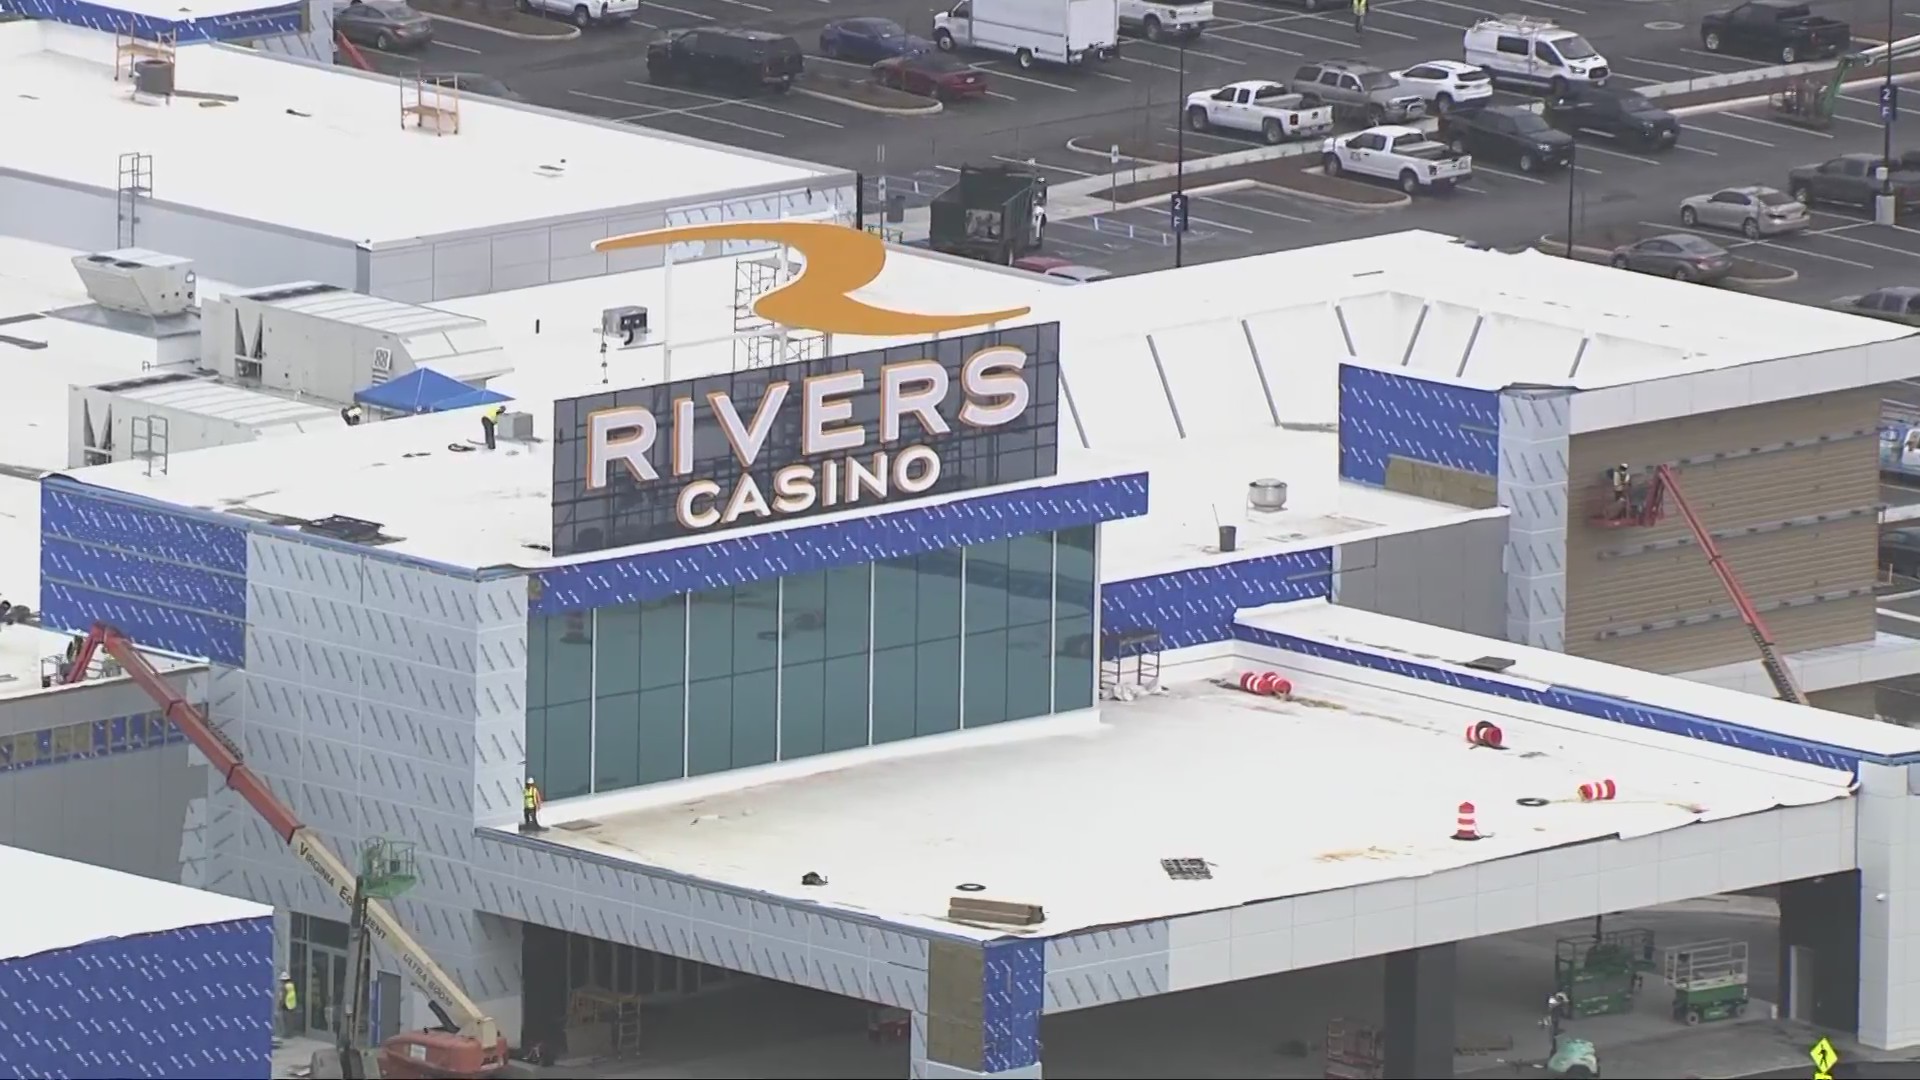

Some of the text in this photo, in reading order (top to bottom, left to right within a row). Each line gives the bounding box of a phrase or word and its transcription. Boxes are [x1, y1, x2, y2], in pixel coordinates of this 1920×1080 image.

[1882, 88, 1891, 100] 2
[1174, 197, 1182, 210] 2
[586, 345, 1030, 490] RIVERS
[676, 445, 941, 528] CASINO
[299, 841, 336, 887] VIRGINIA
